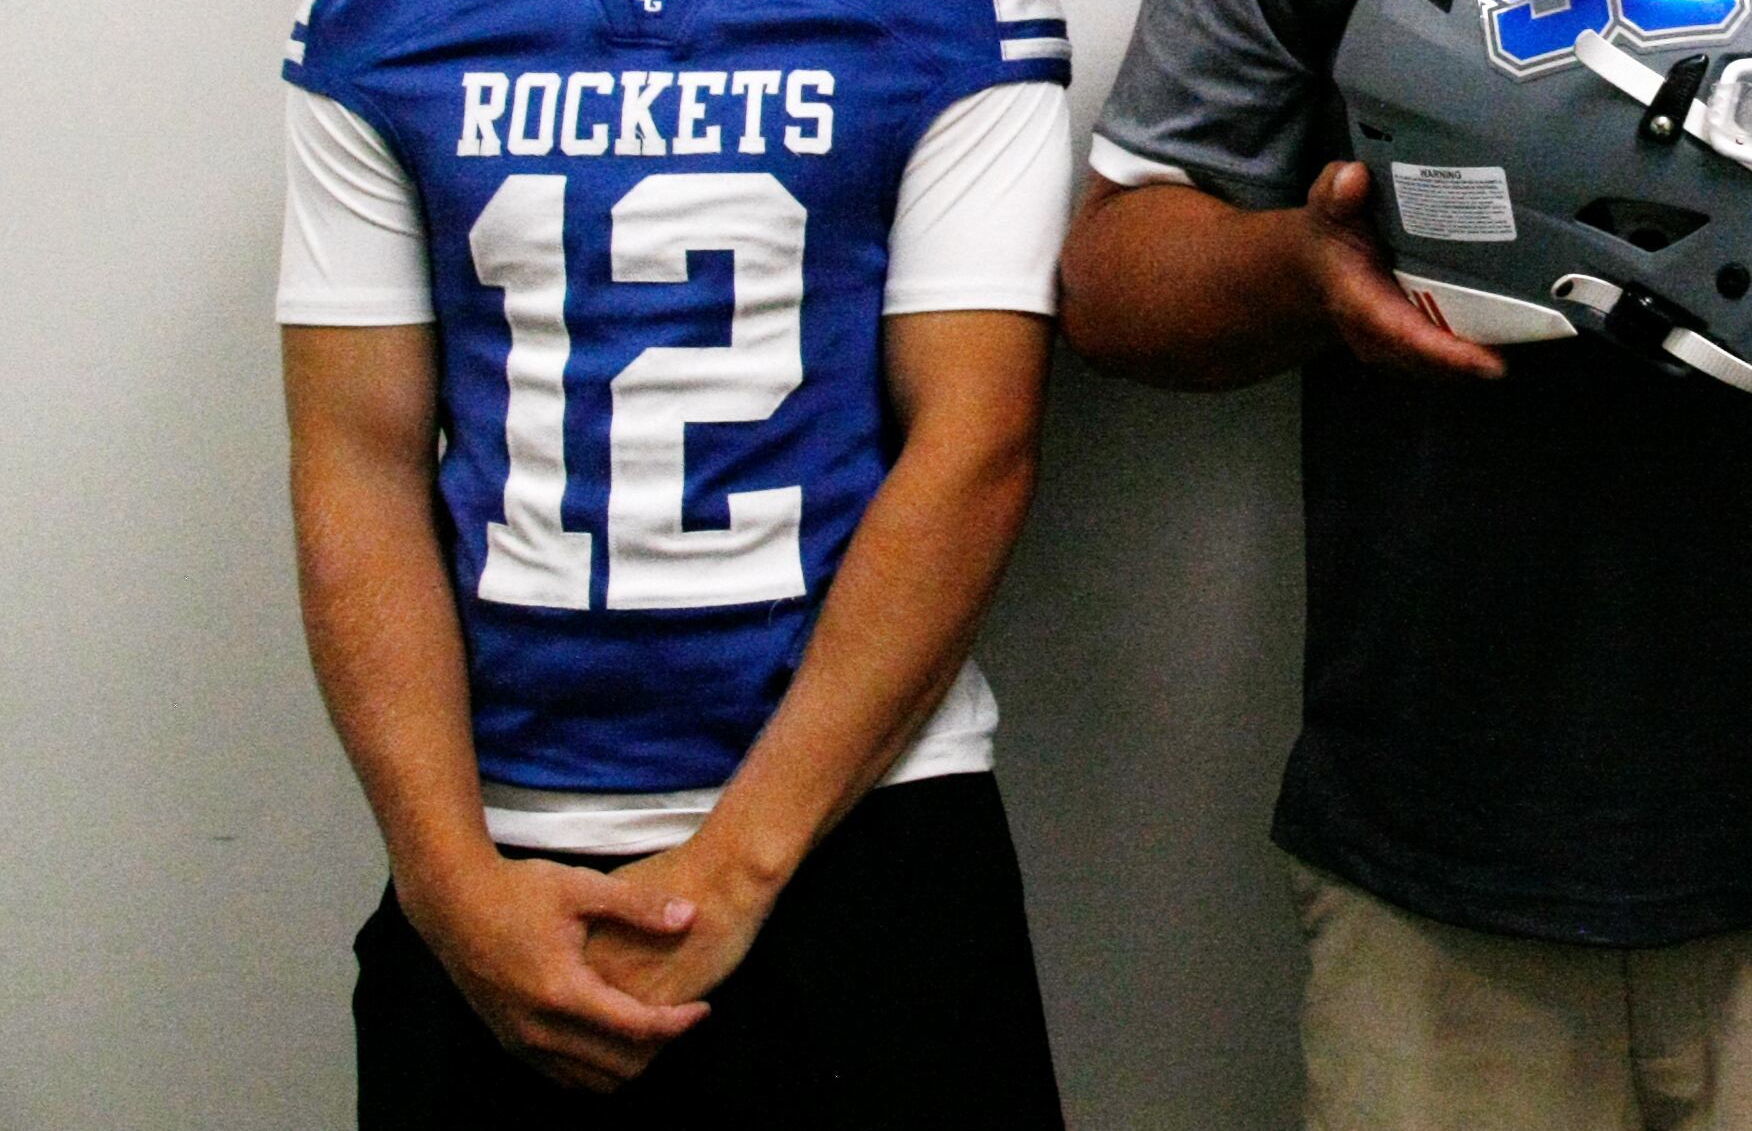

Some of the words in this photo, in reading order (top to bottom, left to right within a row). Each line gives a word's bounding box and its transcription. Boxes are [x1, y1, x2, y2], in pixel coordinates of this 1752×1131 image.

[456, 69, 836, 158] ROCKETS
[1419, 169, 1462, 180] WARNING
[468, 172, 808, 611] 12
